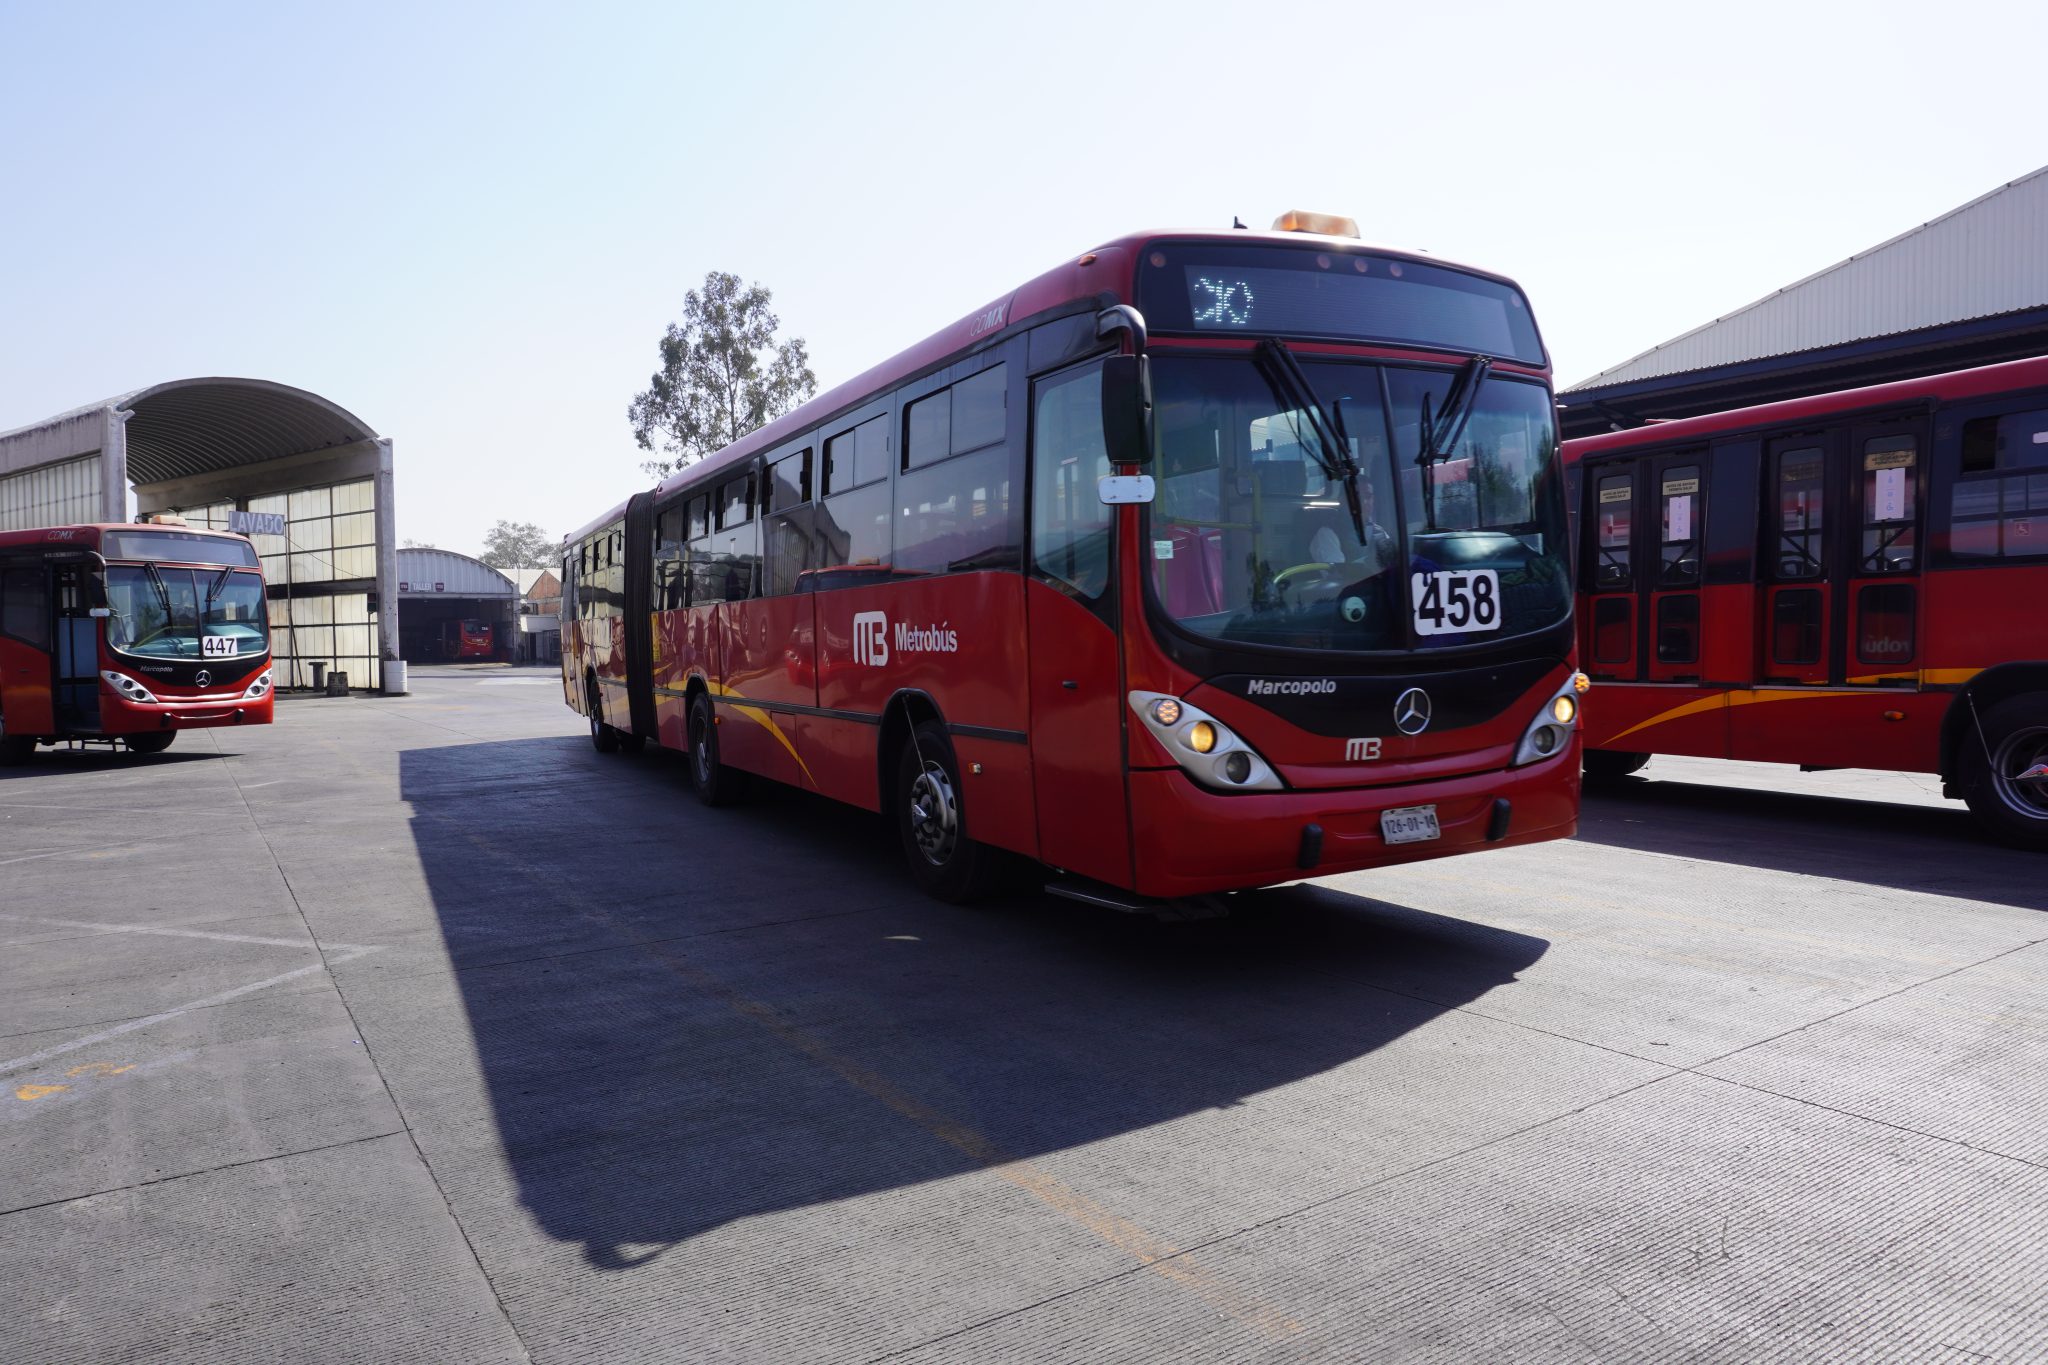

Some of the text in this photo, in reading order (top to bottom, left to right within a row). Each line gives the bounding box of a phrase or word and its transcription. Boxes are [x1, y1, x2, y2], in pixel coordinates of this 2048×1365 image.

[970, 303, 1007, 337] CDMX
[229, 511, 284, 535] LAVADO
[1418, 574, 1496, 628] 458
[204, 637, 236, 655] 447
[894, 620, 958, 653] Metrobús
[140, 665, 174, 673] Marcopolo
[1248, 679, 1337, 696] Marcopolo
